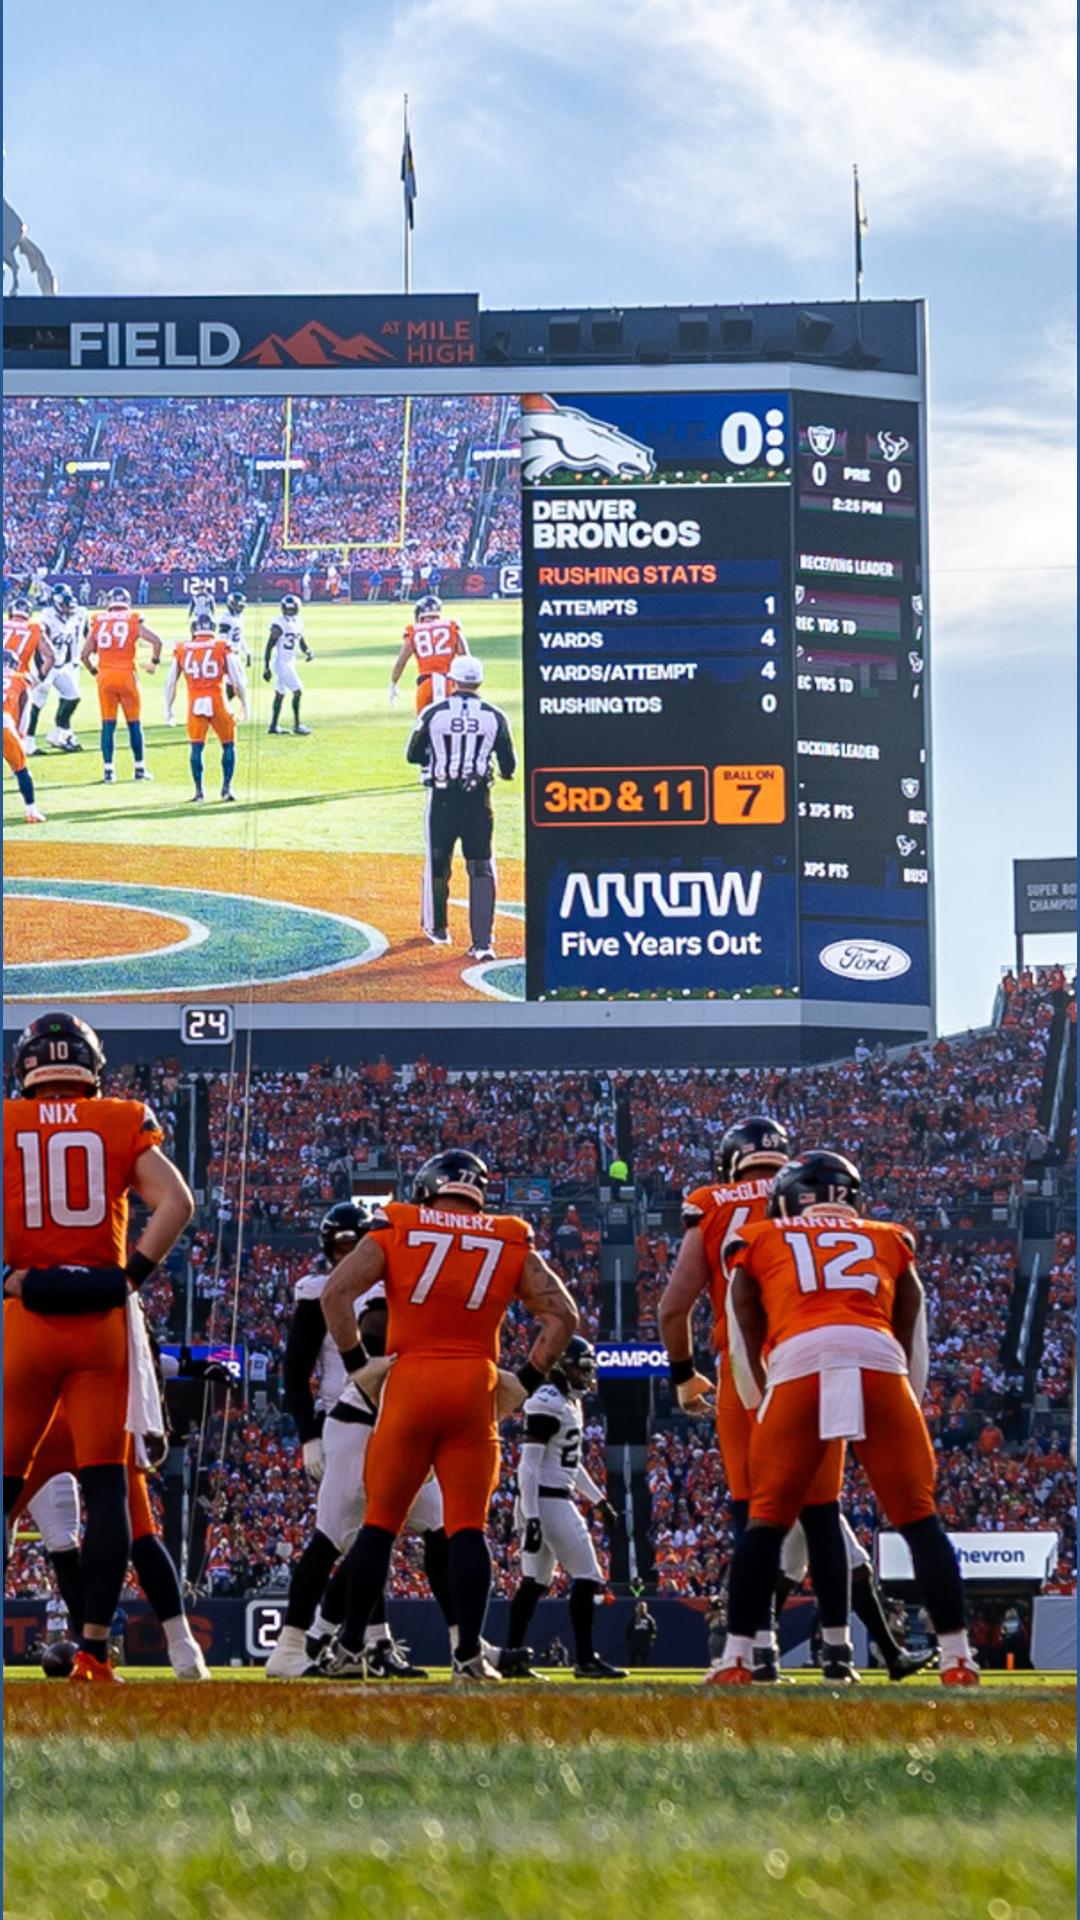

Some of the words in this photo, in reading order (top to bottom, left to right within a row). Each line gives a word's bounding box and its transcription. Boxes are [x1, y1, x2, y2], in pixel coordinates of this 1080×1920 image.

[382, 321, 402, 334] AT
[407, 320, 470, 340] MILE
[70, 322, 241, 366] FIELD
[407, 344, 475, 363] HIGH
[721, 412, 763, 465] 0
[533, 499, 637, 521] DENVER
[533, 521, 701, 549] BRONCOS
[539, 566, 639, 585] RUSHING
[643, 565, 717, 584] STATS
[854, 560, 894, 576] LEADER
[539, 599, 638, 616] ATTEMPTS
[764, 596, 776, 615] 1
[97, 621, 129, 649] 69
[413, 627, 451, 658] 82
[539, 632, 603, 648] YARDS
[760, 628, 776, 647] 4
[184, 648, 219, 680] 46
[540, 663, 697, 681] YARDS/ATTEMPT
[760, 661, 776, 679] 4
[540, 697, 625, 714] RUSHING
[624, 697, 662, 713] TDS
[761, 694, 776, 713] 0
[450, 718, 479, 733] 83
[841, 743, 880, 760] LEADER
[723, 770, 754, 781] BALL
[757, 770, 774, 780] ON
[544, 781, 612, 812] 3RD
[616, 780, 644, 811] &
[653, 780, 693, 811] 11
[736, 784, 762, 817] 7
[828, 862, 849, 879] PTS
[560, 871, 762, 918] ARROW
[561, 932, 619, 956] Five
[623, 932, 702, 956] Years
[707, 930, 762, 955] Out
[839, 945, 891, 971] Ford
[189, 1011, 226, 1037] 24
[49, 1041, 69, 1061] 10
[39, 1104, 77, 1124] NIX
[16, 1131, 106, 1228] 10
[828, 1184, 848, 1205] 12
[419, 1204, 495, 1232] MEINERZ
[407, 1230, 504, 1310] 77
[784, 1231, 879, 1296] 12
